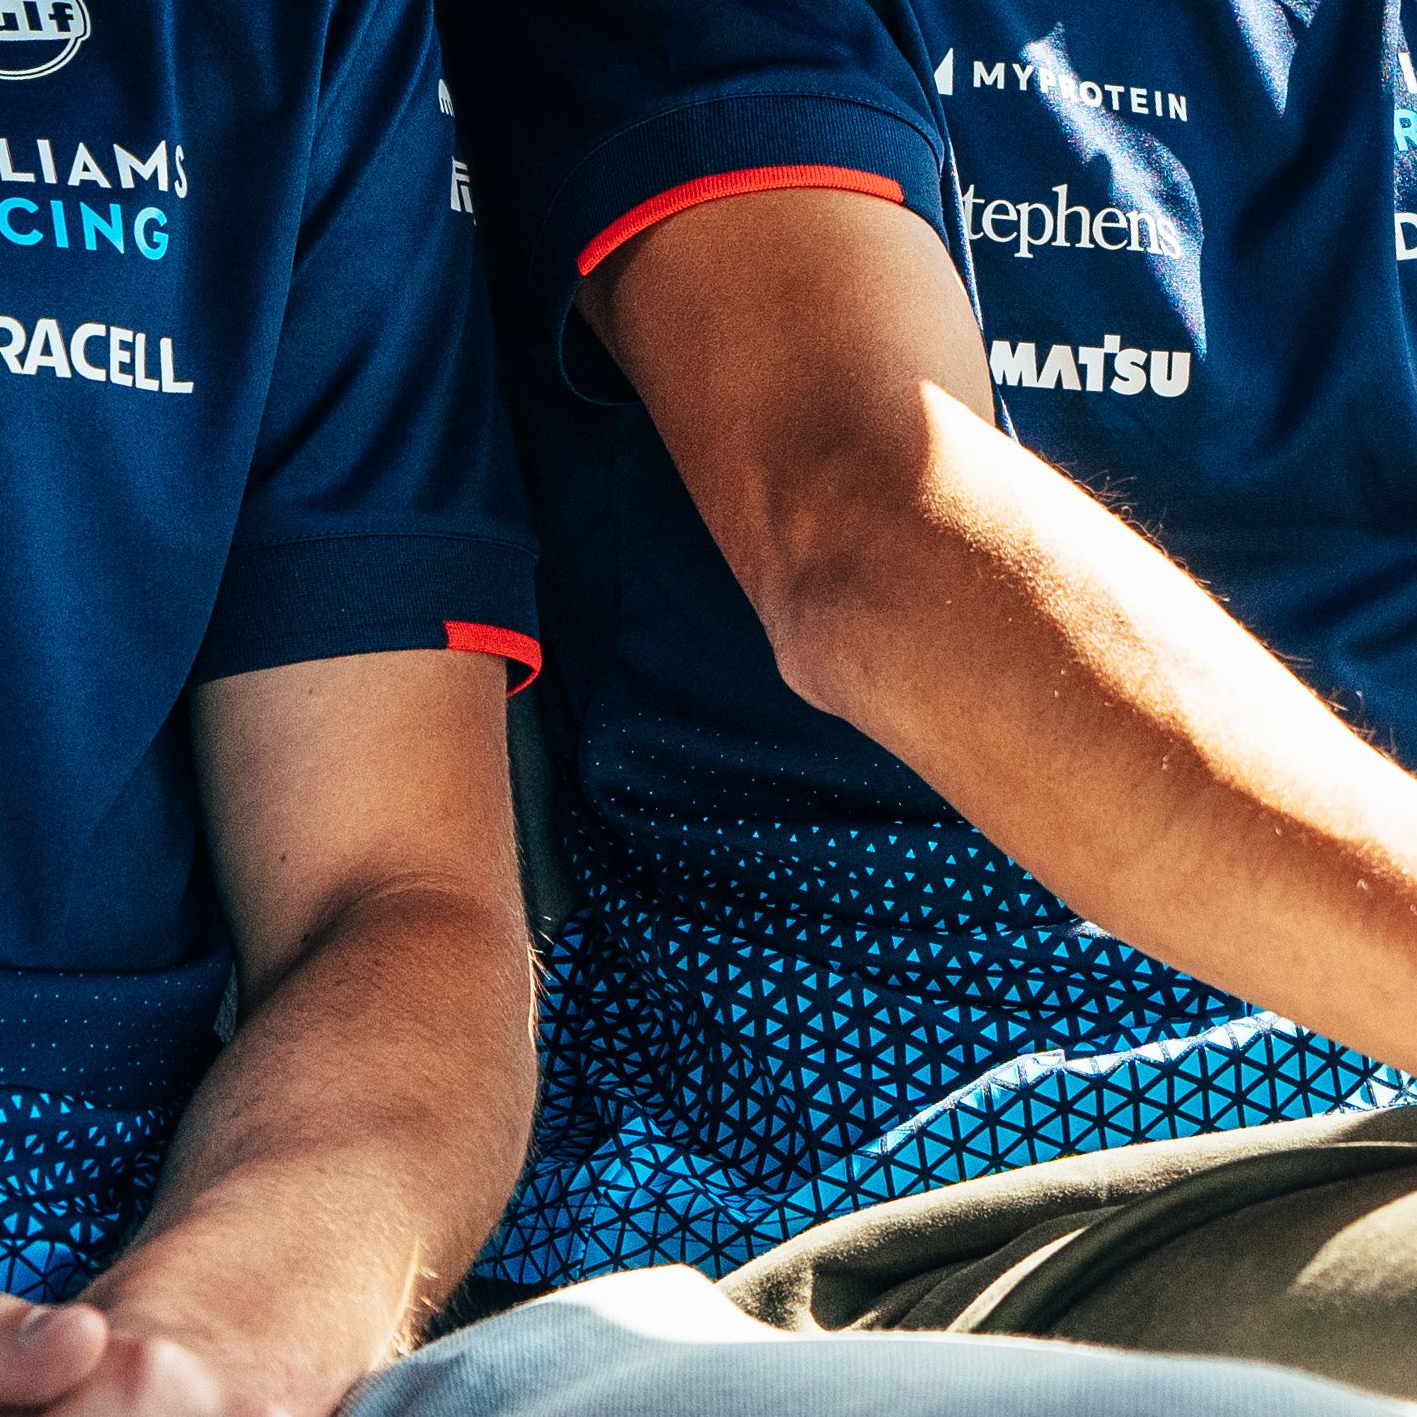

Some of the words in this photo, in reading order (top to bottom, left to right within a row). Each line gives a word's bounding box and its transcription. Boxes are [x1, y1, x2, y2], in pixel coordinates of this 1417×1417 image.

[973, 60, 1189, 122] MYPROTEIN
[961, 183, 1183, 260] tephens
[989, 333, 1193, 399] MATSU
